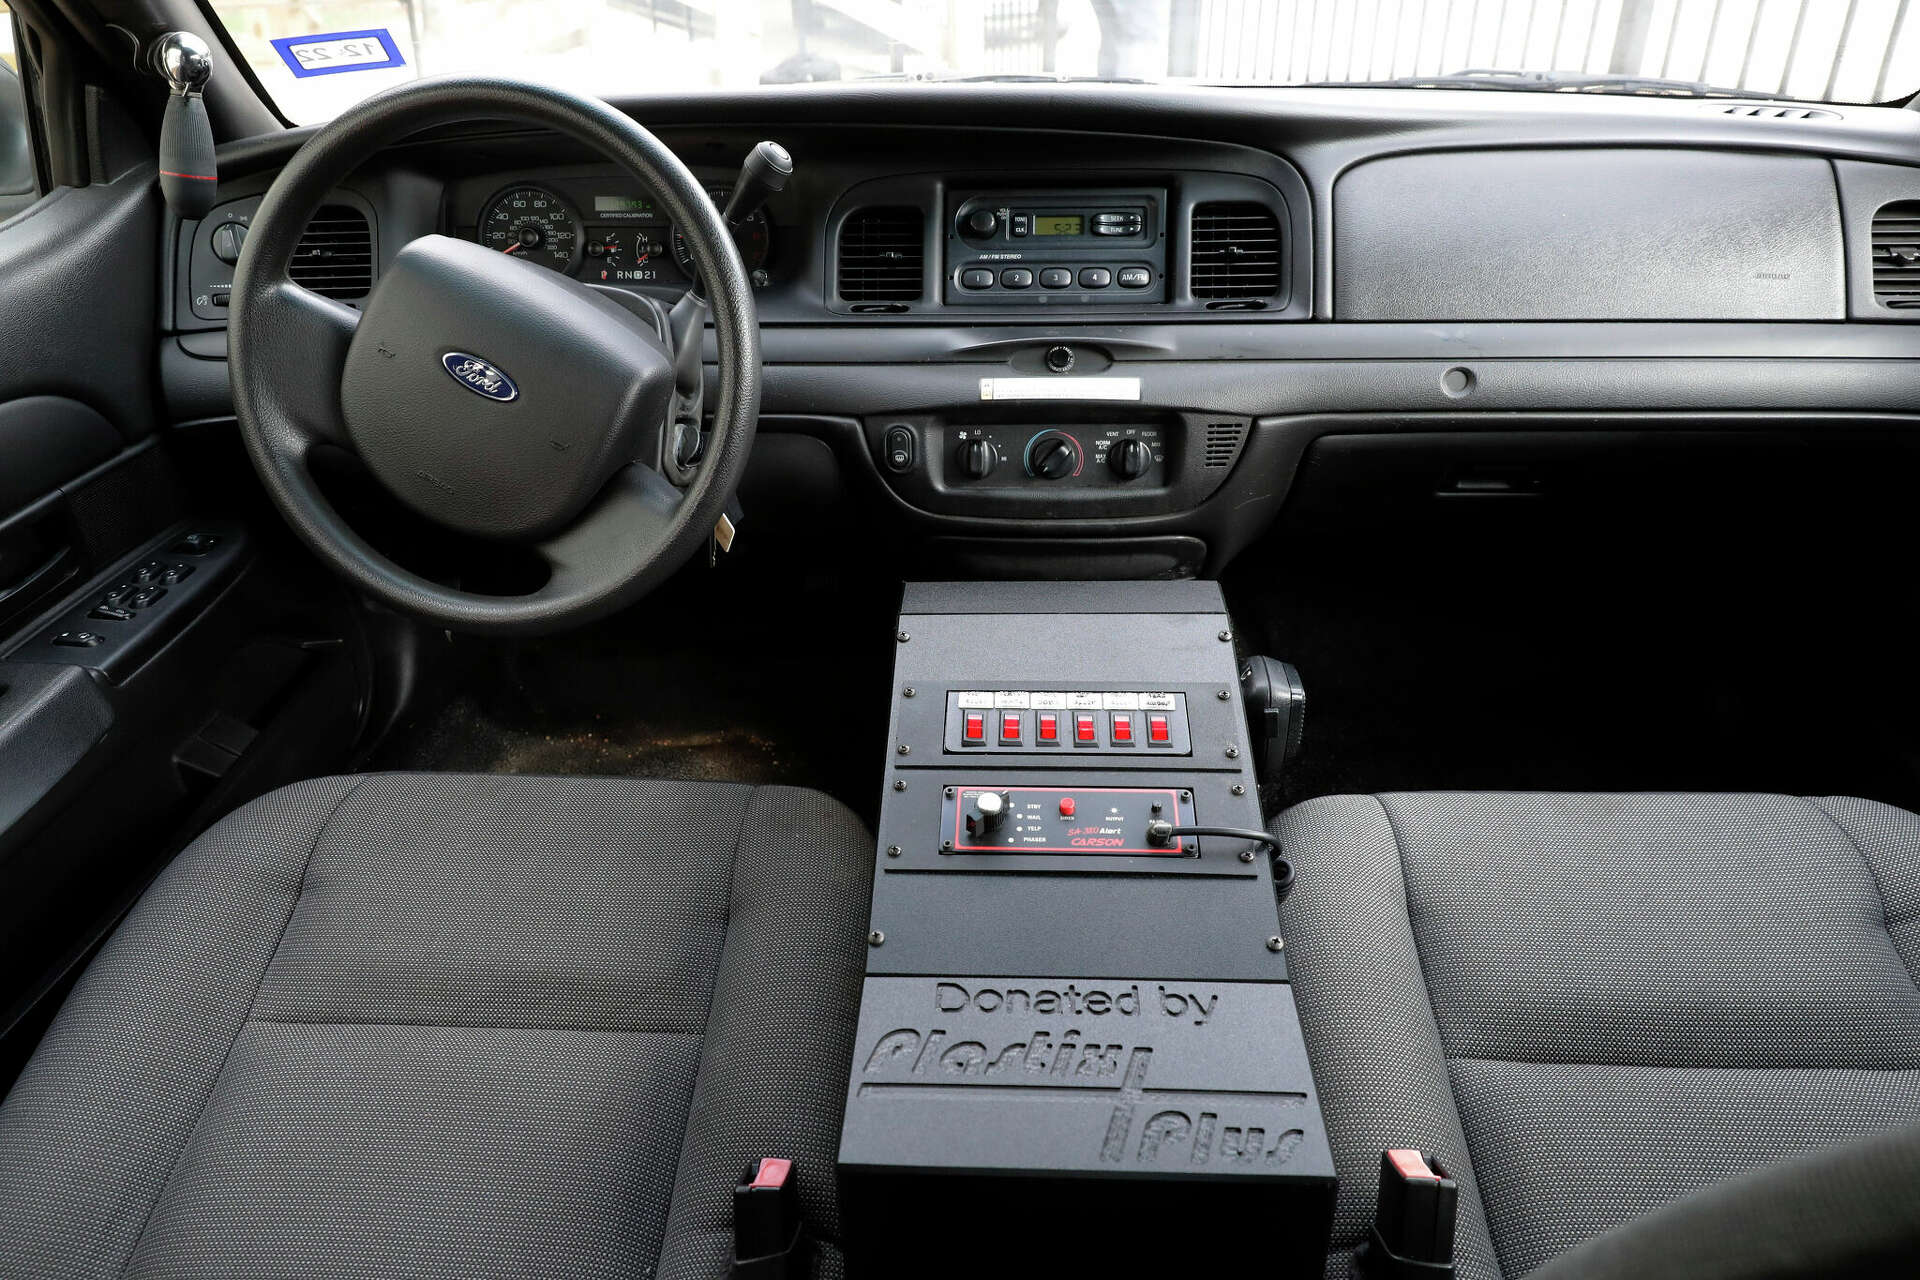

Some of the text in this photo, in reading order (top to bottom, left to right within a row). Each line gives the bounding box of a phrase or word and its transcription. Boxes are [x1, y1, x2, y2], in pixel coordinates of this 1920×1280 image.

[1122, 273, 1147, 281] AM/FM
[453, 360, 502, 393] Ford
[1071, 837, 1125, 846] CARSON
[935, 982, 1219, 1025] Donated by
[1138, 1110, 1305, 1164] Plus
